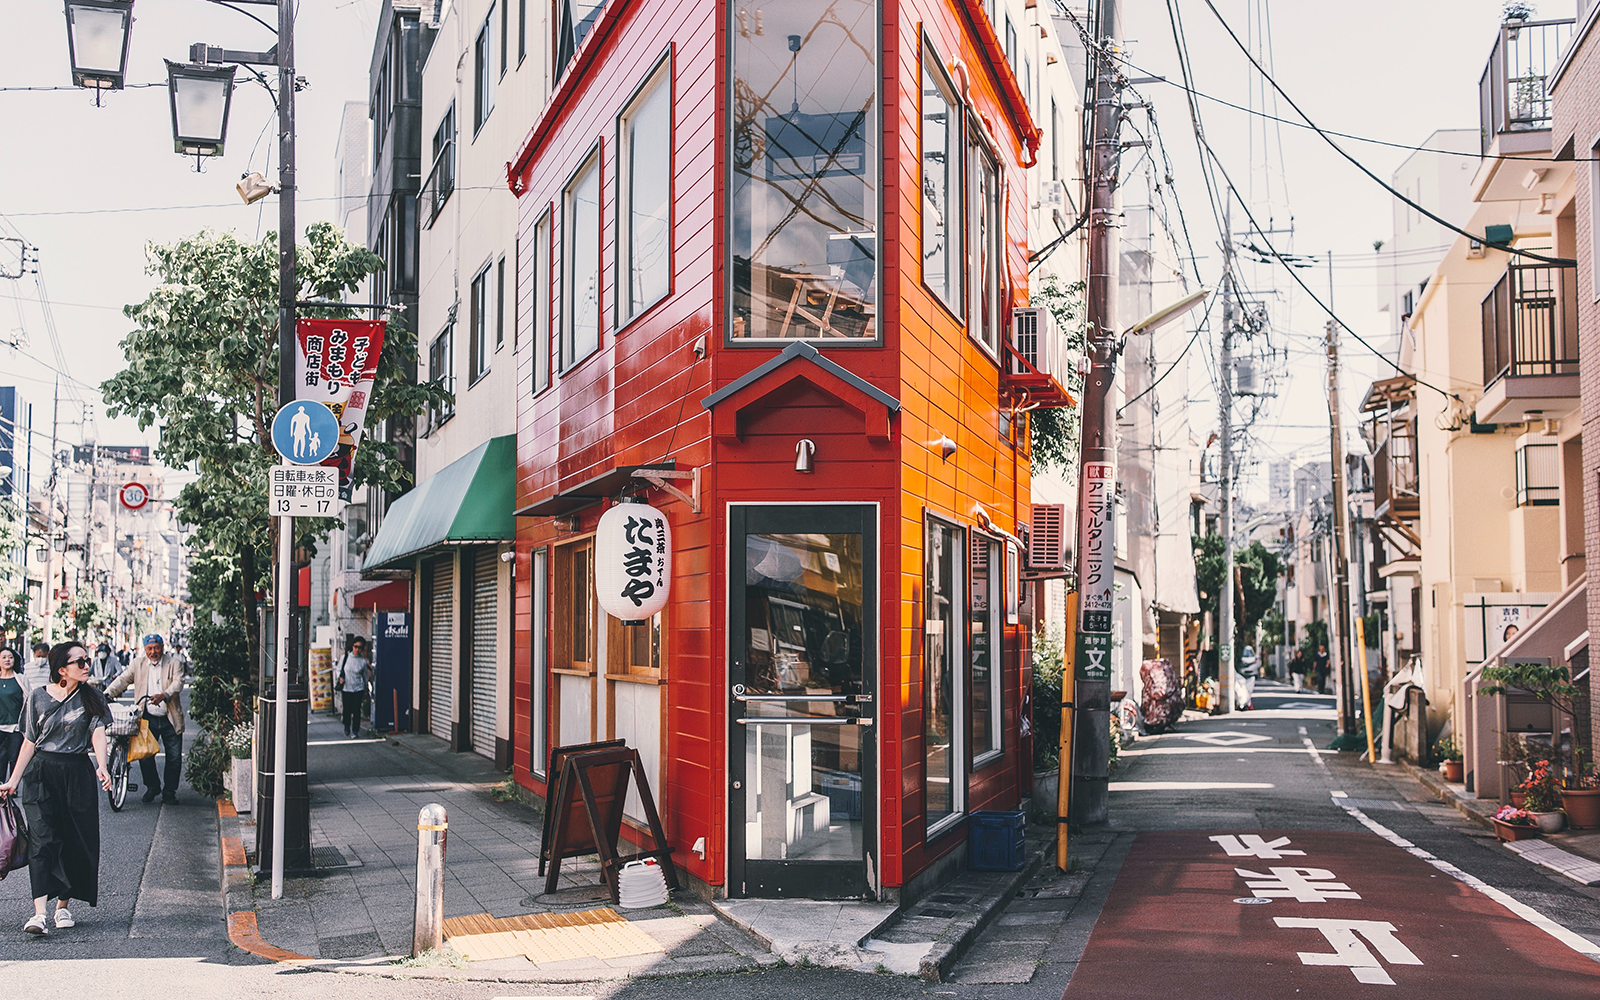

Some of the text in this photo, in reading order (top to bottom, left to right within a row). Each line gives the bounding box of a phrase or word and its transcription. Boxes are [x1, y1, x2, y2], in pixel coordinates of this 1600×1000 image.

[305, 335, 324, 387] 商店街
[327, 328, 348, 395] みまもり
[349, 336, 370, 386] 子ども
[274, 469, 335, 483] 自転車を除く
[126, 489, 143, 503] 30
[274, 484, 335, 498] 日曜・休日の
[277, 499, 291, 513] 13
[316, 500, 330, 513] 17
[1086, 481, 1104, 586] アニマルクリニック
[621, 515, 655, 607] たまや
[384, 625, 409, 634] Asahi
[1084, 636, 1107, 645] 通学路
[1084, 646, 1106, 671] 文
